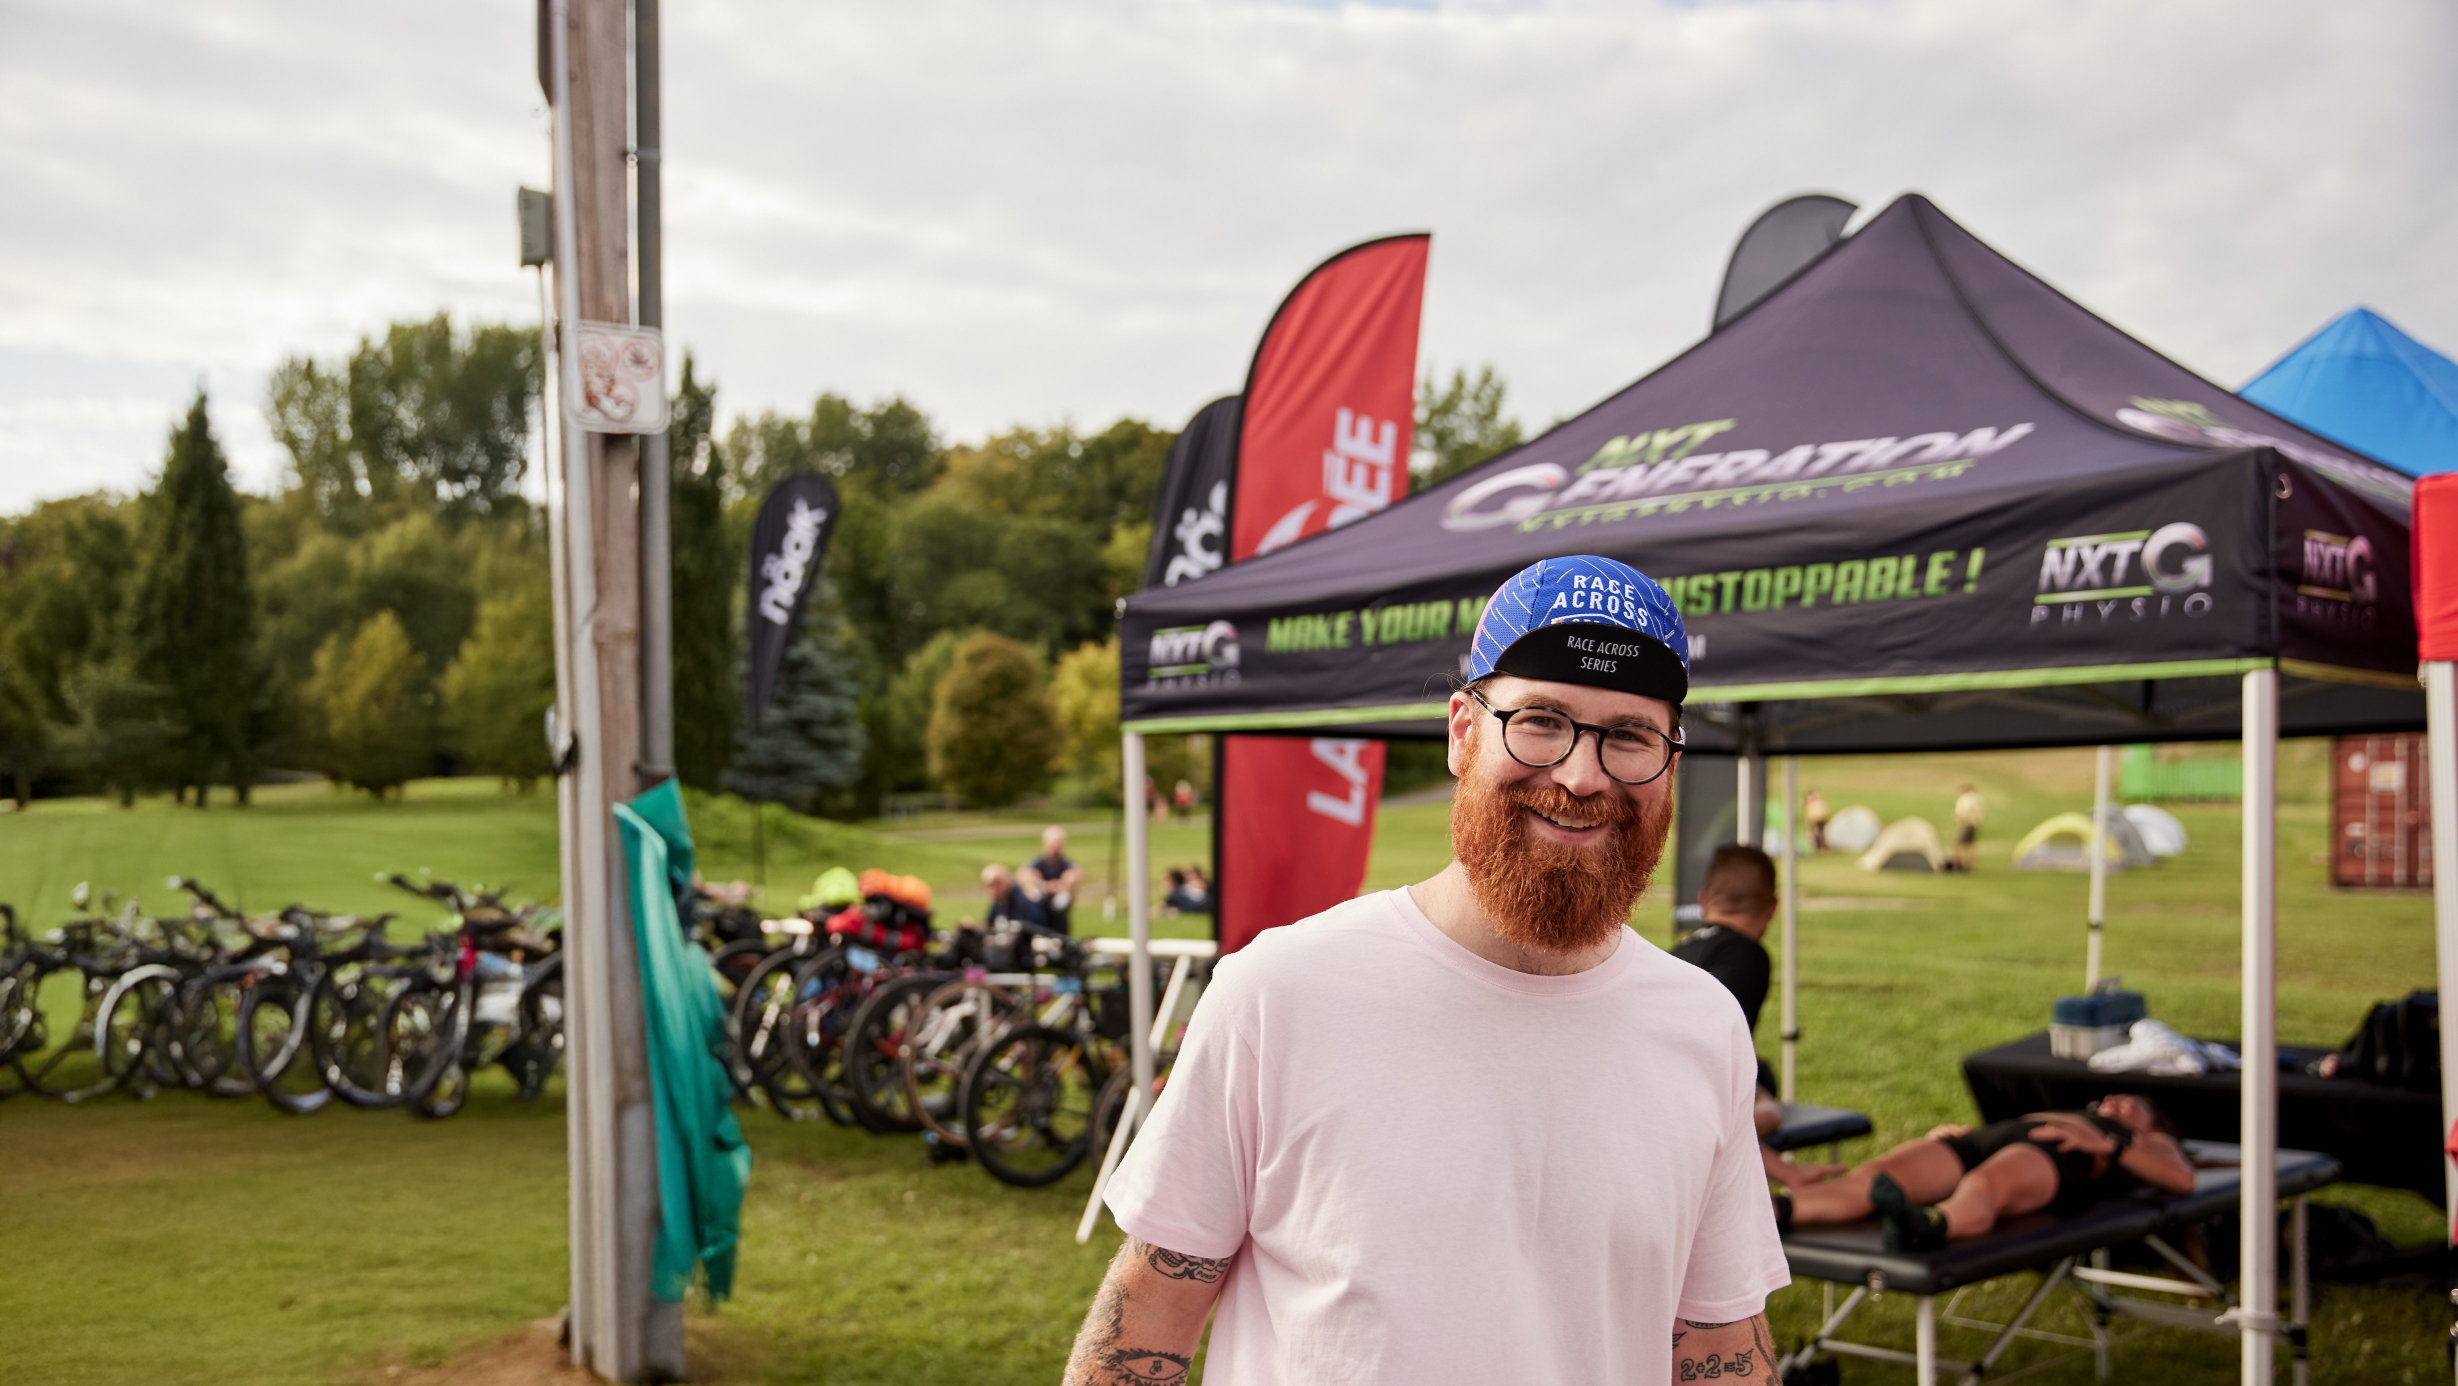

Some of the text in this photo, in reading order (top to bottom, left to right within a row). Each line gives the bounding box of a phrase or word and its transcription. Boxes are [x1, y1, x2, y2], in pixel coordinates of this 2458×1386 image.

[1440, 421, 2036, 532] GENERATION
[1573, 575, 1635, 600] RACE
[1265, 611, 1355, 653] MAKE
[1360, 600, 1451, 646] YOUR
[1553, 590, 1648, 627] ACROSS
[2030, 592, 2213, 630] PHYSIO
[1567, 635, 1640, 657] RACE ACROSS
[1580, 656, 1617, 673] SERIES
